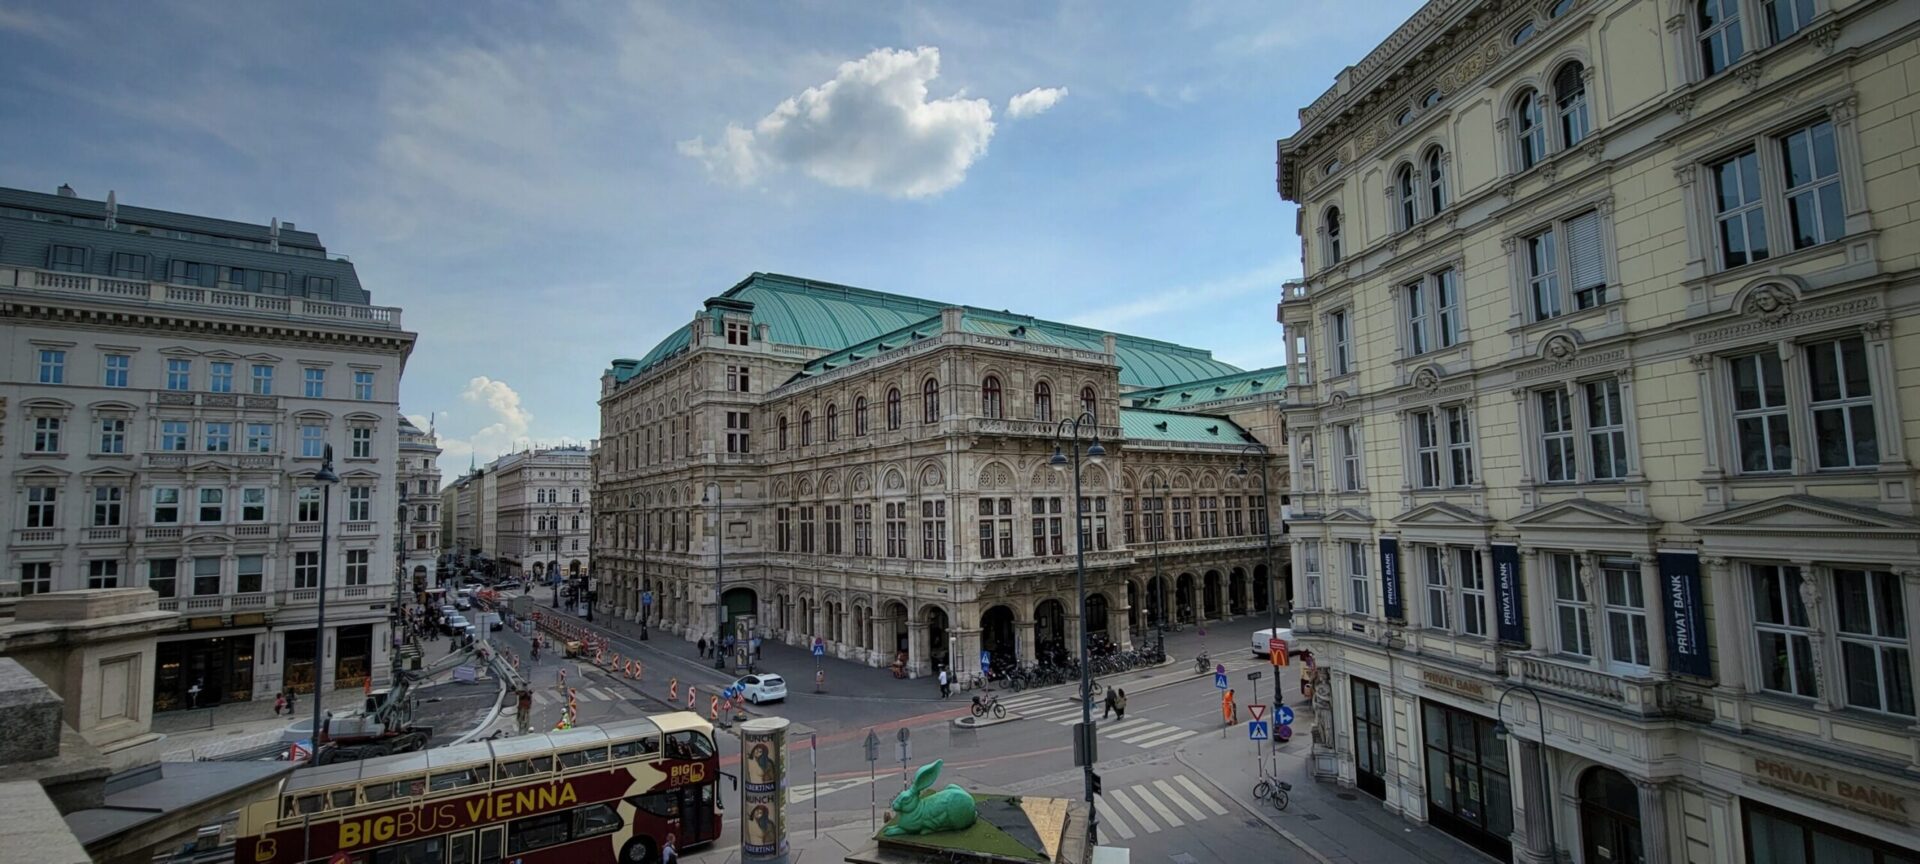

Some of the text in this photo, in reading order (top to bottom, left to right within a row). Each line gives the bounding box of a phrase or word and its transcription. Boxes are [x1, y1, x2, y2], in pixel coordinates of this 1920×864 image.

[1384, 553, 1392, 576] BANK
[1500, 562, 1512, 625] PRIVAT BANK
[1671, 575, 1689, 654] PRIVAT BANK
[1424, 671, 1484, 696] PRIVAT BANK
[671, 764, 690, 777] BIG
[671, 775, 689, 787] BUS
[1755, 759, 1909, 814] PRIVAT BANK
[466, 782, 577, 823] VIENNA
